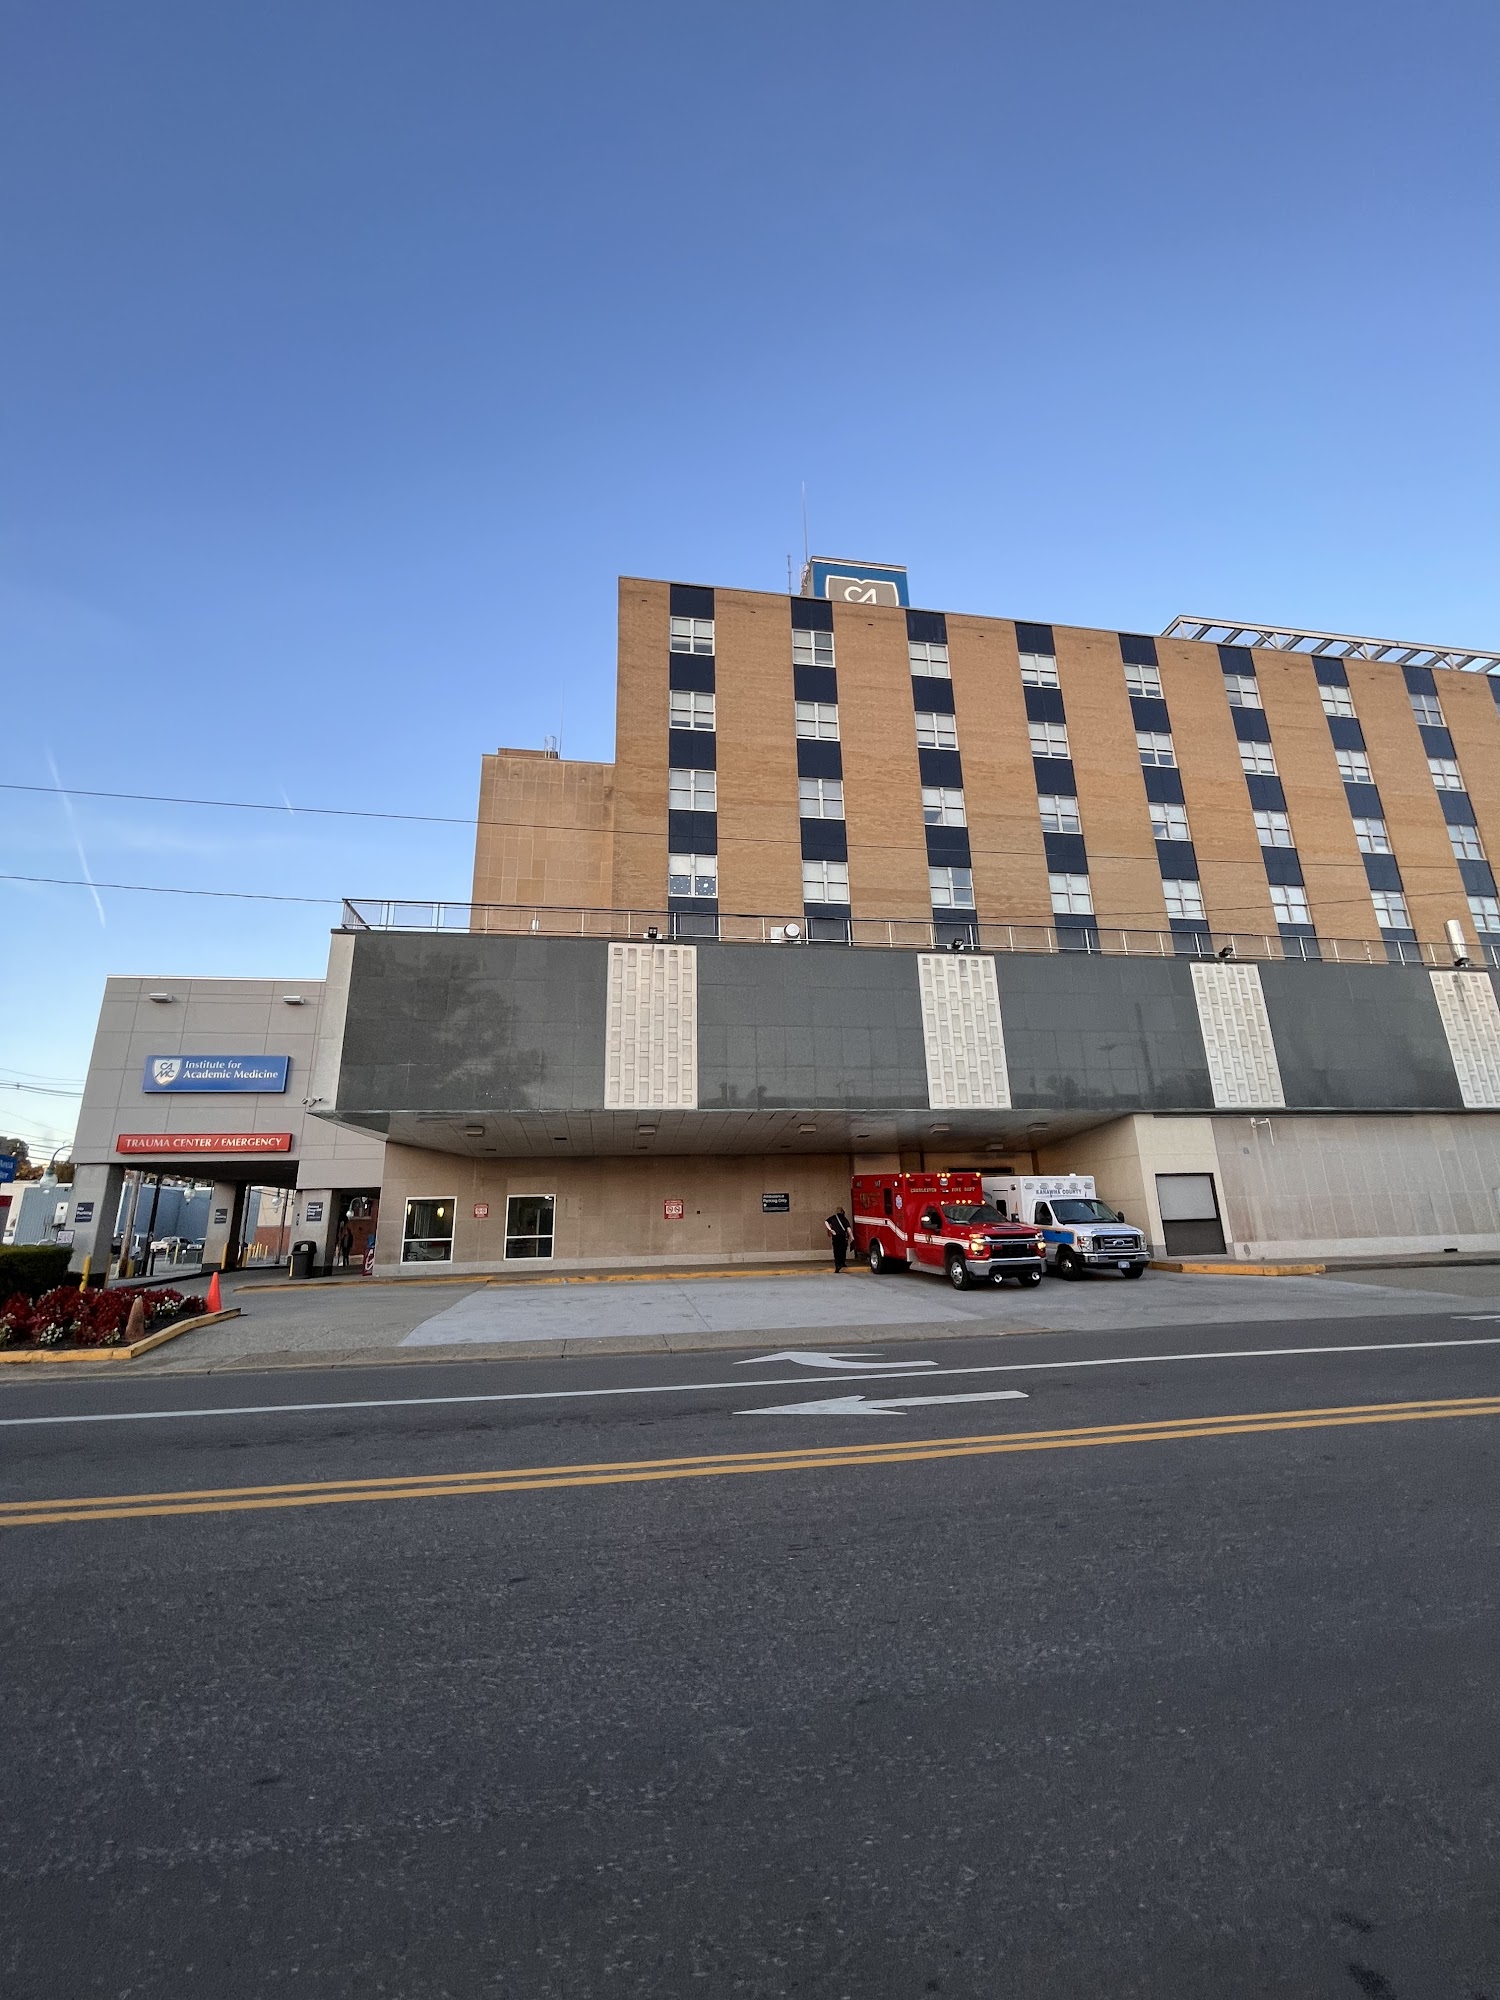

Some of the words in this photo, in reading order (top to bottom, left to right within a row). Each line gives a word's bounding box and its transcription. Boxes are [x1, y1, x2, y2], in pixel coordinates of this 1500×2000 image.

[185, 1060, 225, 1069] Institute
[228, 1060, 242, 1069] for
[183, 1070, 231, 1079] Academic
[234, 1070, 279, 1079] Medicine
[125, 1138, 170, 1148] TRAUMA
[173, 1138, 212, 1147] CENTER
[221, 1137, 283, 1146] EMERGENCY
